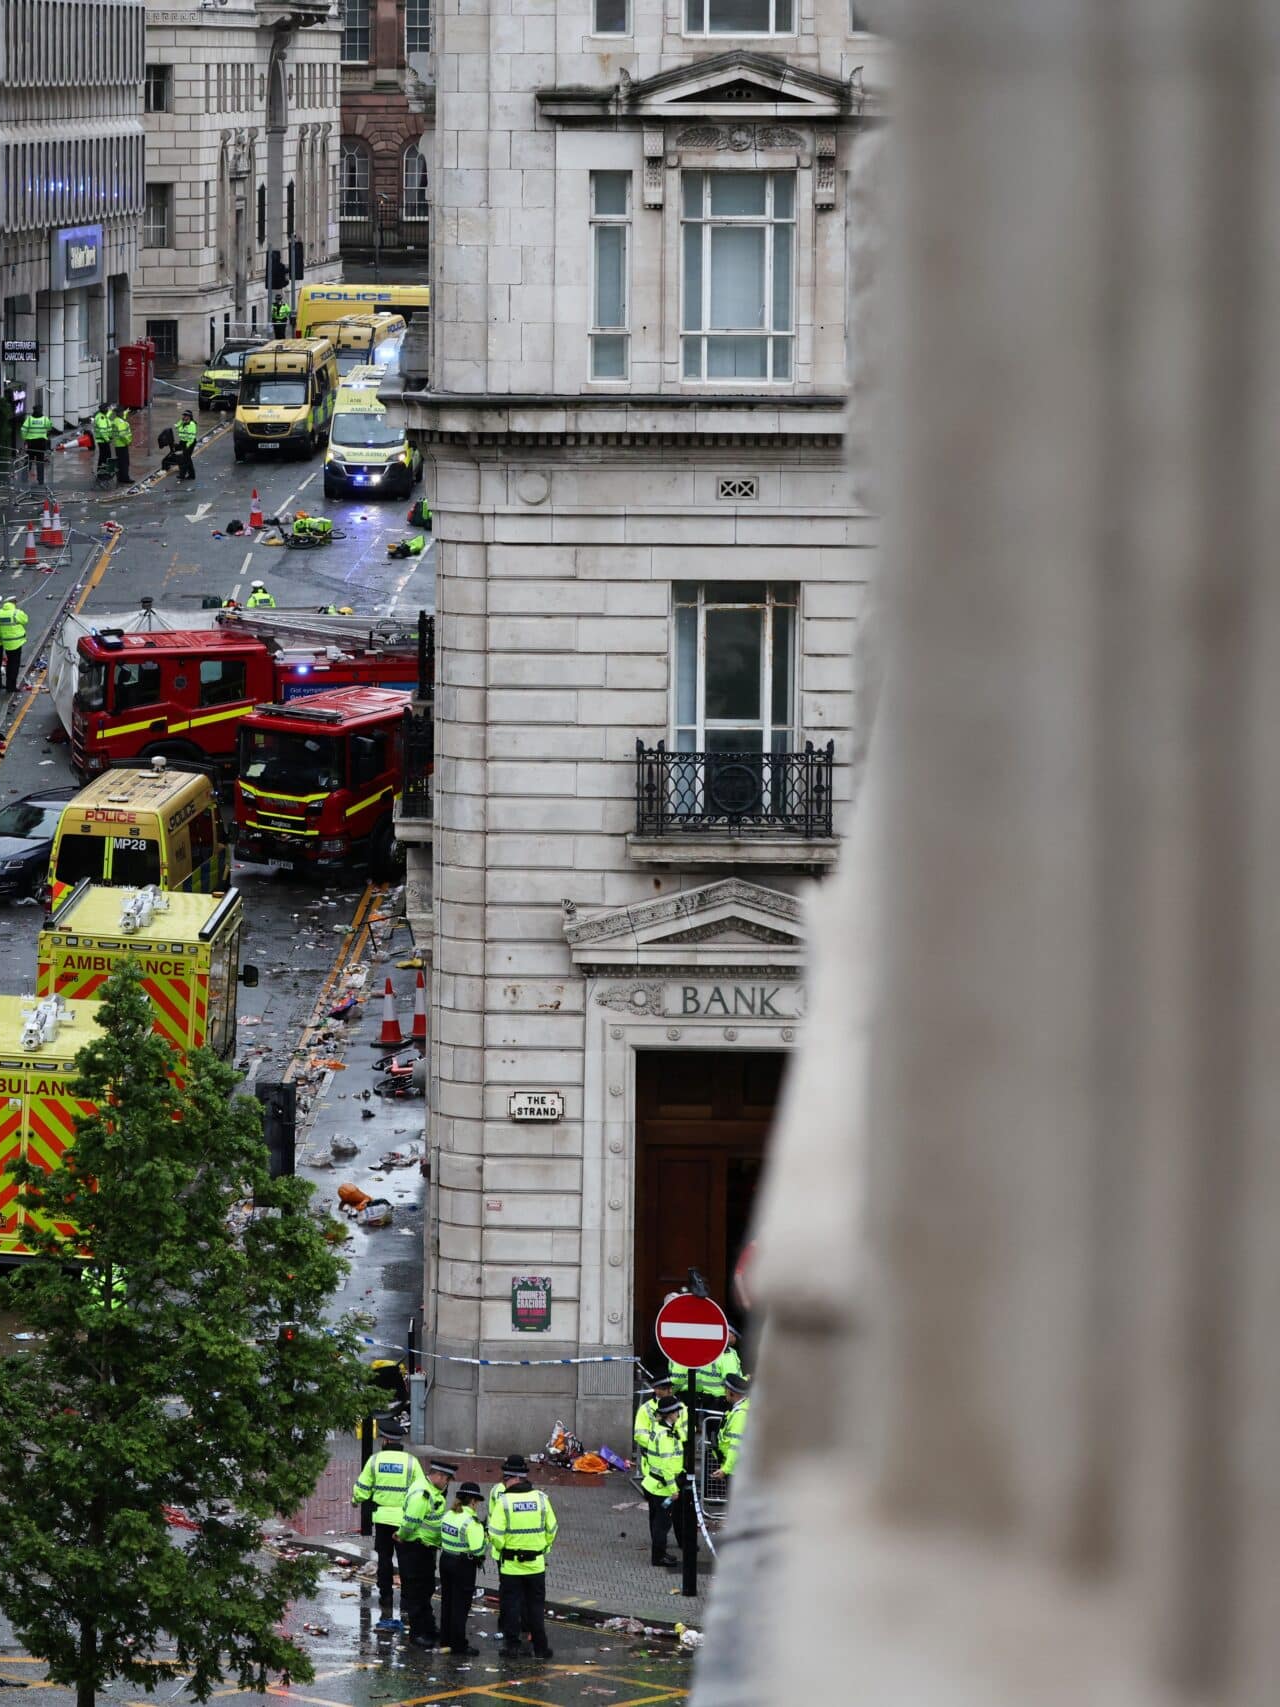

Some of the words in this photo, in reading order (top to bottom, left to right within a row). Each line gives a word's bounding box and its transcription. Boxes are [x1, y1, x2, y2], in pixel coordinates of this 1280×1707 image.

[311, 292, 392, 301] POLICE
[85, 810, 136, 823] POLICE
[113, 838, 146, 851] MP28
[63, 955, 185, 976] AMBUANCE
[682, 986, 780, 1015] BANK
[528, 1096, 546, 1105] THE
[517, 1107, 556, 1116] STRAND
[380, 1464, 403, 1473] POLICE
[513, 1502, 537, 1511] POLICE
